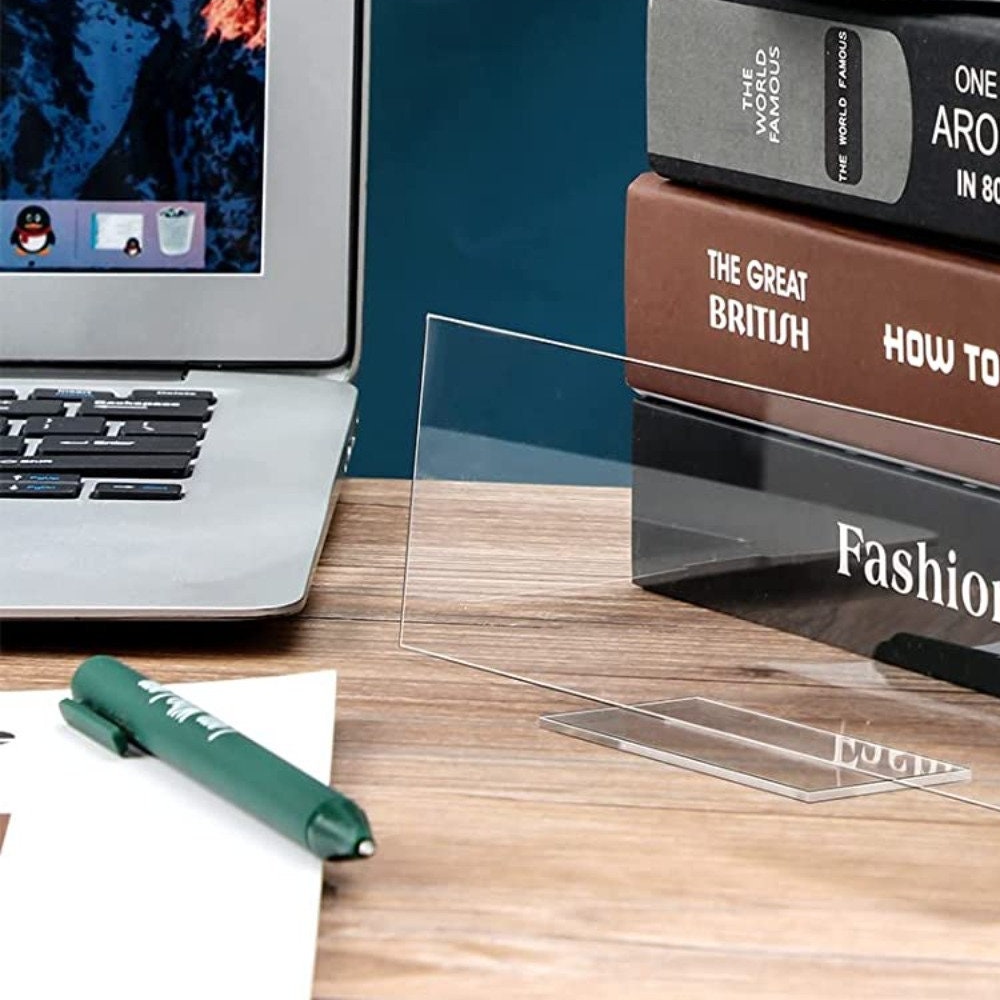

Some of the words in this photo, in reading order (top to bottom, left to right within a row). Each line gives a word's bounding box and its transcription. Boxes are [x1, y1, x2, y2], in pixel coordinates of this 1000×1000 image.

[837, 30, 848, 90] FAMOUS
[955, 65, 998, 99] ONE
[742, 67, 754, 111] THE
[755, 48, 768, 135] WORLD
[768, 46, 781, 144] FAMOUS
[837, 96, 848, 146] WORLD
[837, 153, 848, 183] THE
[957, 169, 976, 199] IN
[707, 249, 741, 285] THE
[746, 259, 808, 302] GREAT
[709, 294, 809, 351] BRITISH
[883, 323, 955, 374] HOW
[963, 343, 1000, 387] TO
